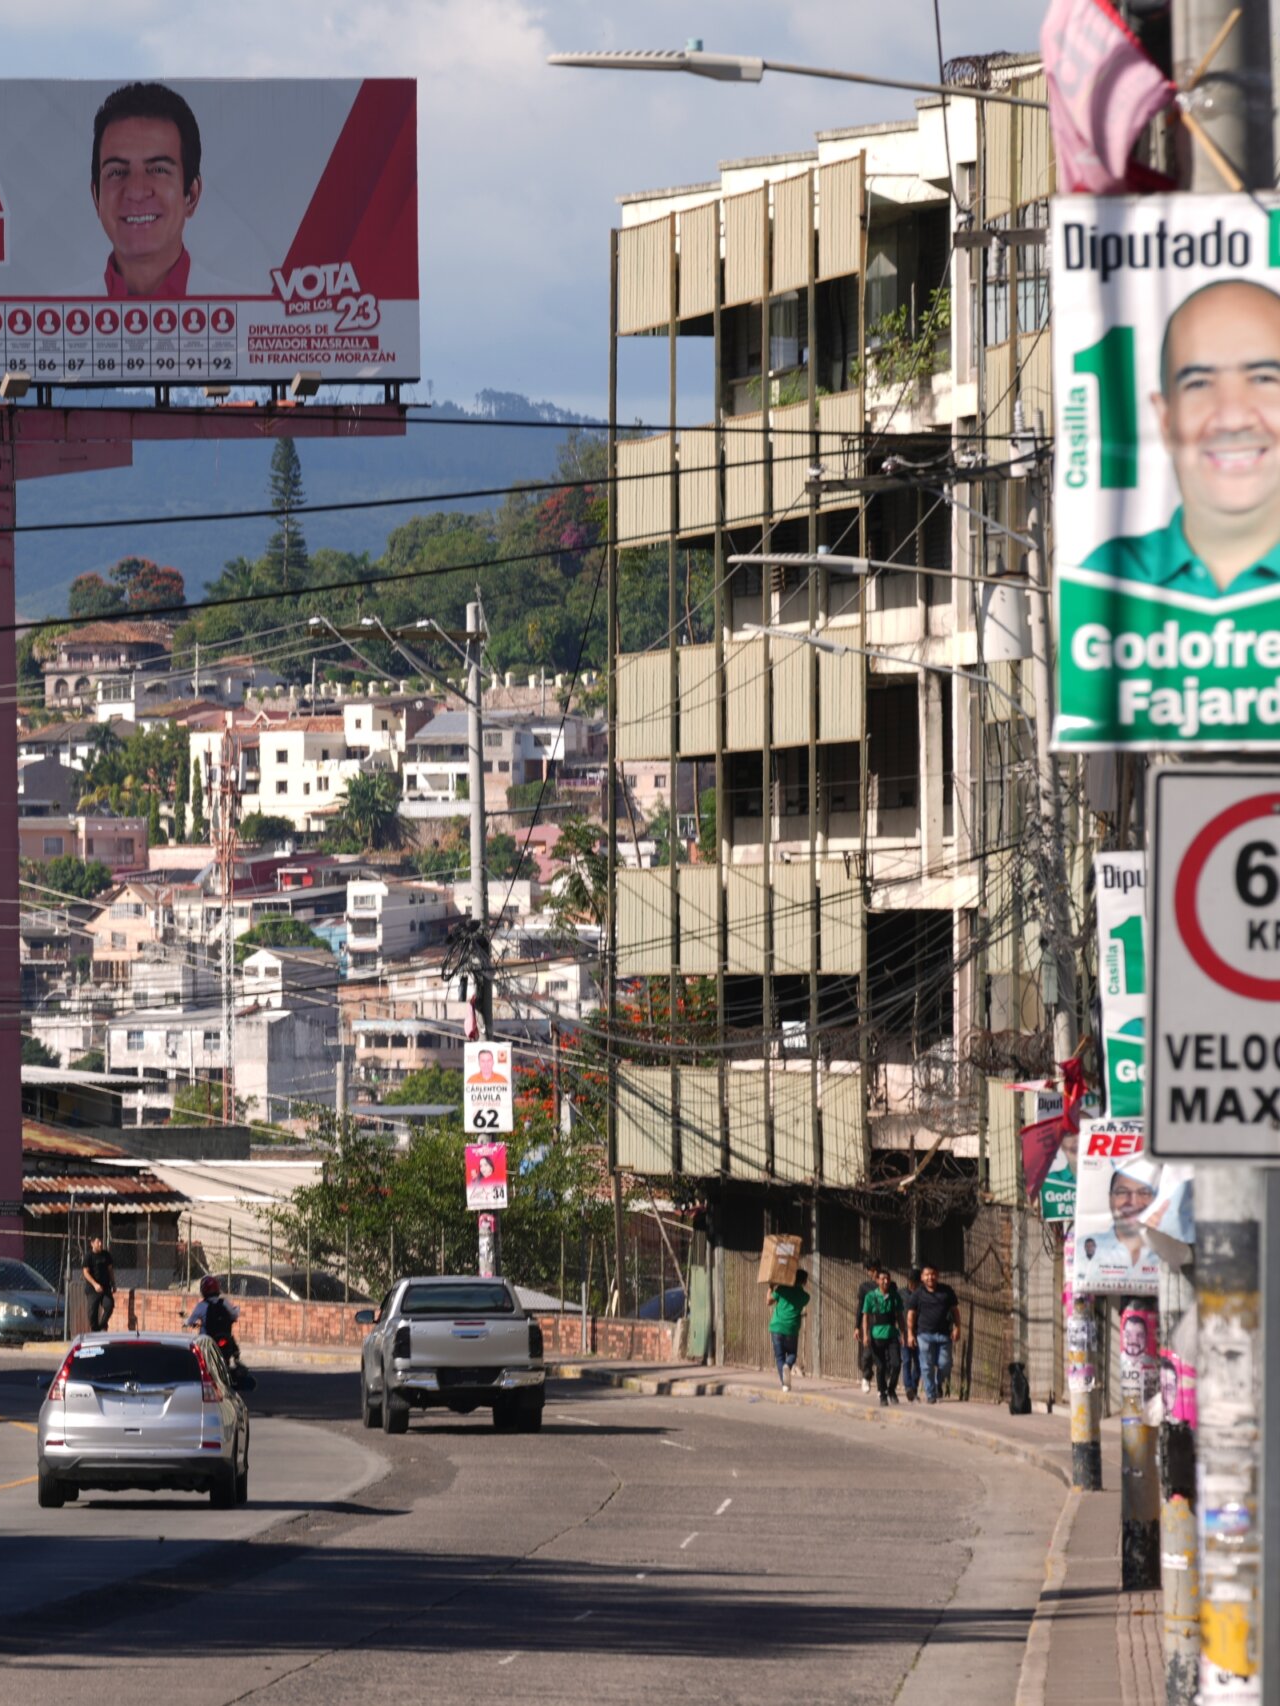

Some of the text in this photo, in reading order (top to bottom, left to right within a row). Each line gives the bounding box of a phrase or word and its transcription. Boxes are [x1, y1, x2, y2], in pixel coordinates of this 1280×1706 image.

[1064, 219, 1250, 283] Diputado
[272, 261, 361, 302] VOTA
[249, 324, 328, 335] DIPUTADOS DE
[288, 294, 379, 330] POR LOS 23
[249, 337, 370, 350] SALVADOR NASRALLA
[250, 349, 396, 364] EN FRANCISCO MORAZÁN
[9, 359, 27, 371] 85
[38, 359, 56, 371] 86
[67, 359, 85, 370] 87
[98, 359, 116, 370] 88
[127, 359, 145, 370] 89
[156, 358, 175, 370] 90
[186, 358, 203, 370] 91
[213, 358, 232, 370] 92
[1073, 325, 1137, 488] 1
[1064, 386, 1088, 488] Casilla
[1106, 944, 1120, 995] Casilla
[1109, 915, 1146, 995] 1
[473, 1109, 500, 1129] 62
[493, 1186, 505, 1199] 34
